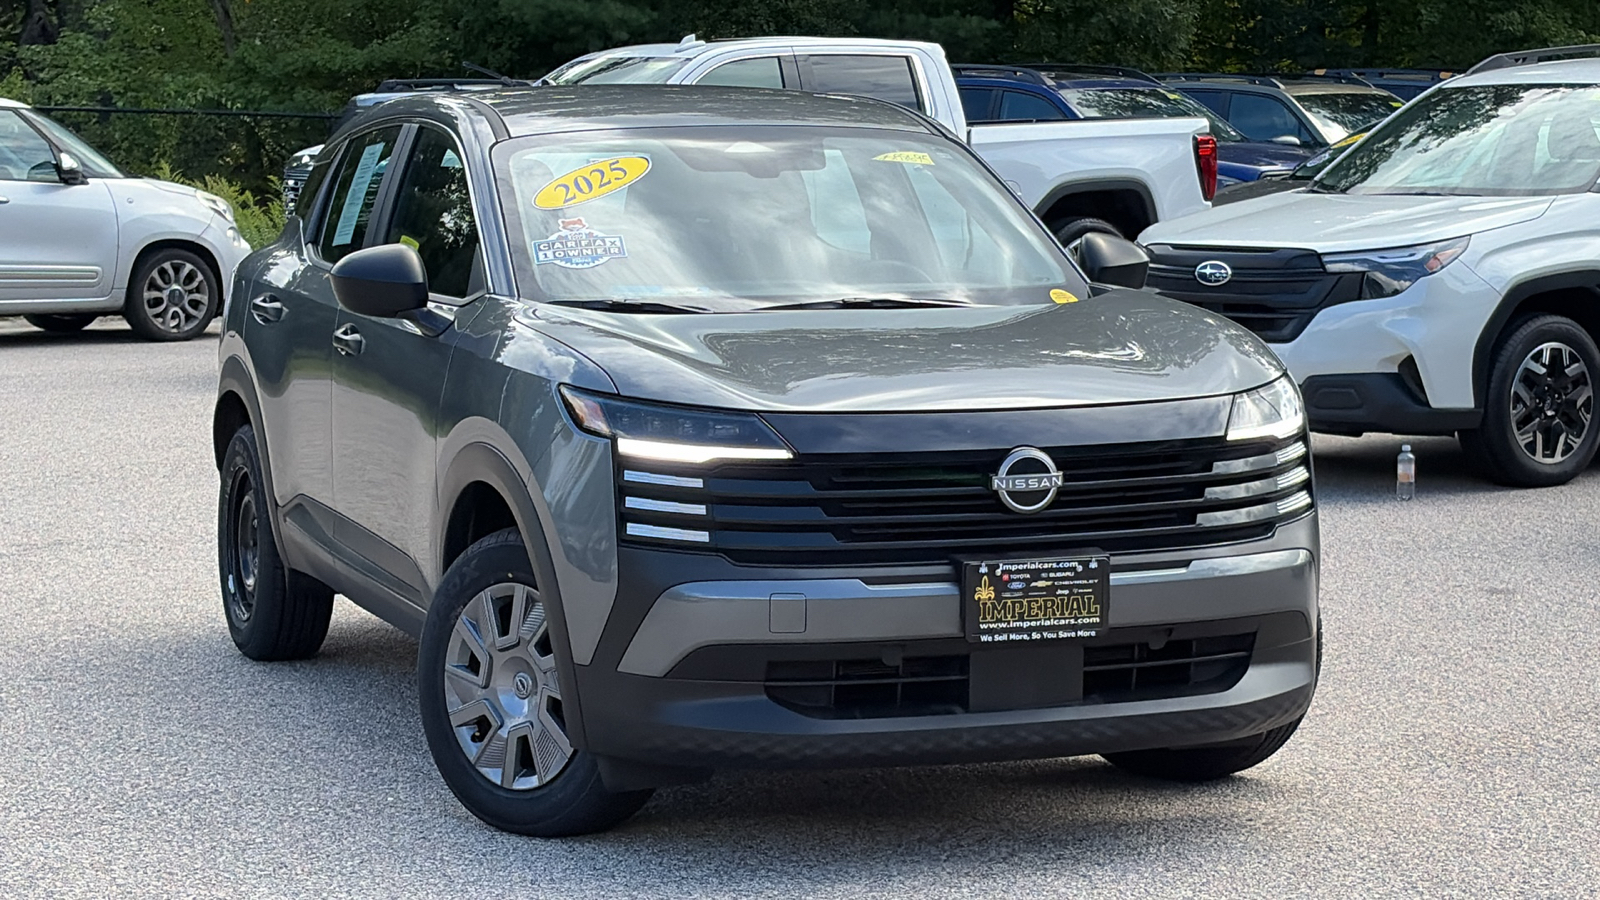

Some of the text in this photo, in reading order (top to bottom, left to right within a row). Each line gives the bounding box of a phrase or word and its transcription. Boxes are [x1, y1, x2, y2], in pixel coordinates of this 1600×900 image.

[554, 160, 628, 204] 2025
[538, 239, 618, 251] CARFAX
[554, 247, 619, 257] OWNER
[994, 476, 1062, 489] NISSAN
[999, 561, 1078, 571] Imperialcars.com
[979, 595, 1100, 622] IMPERIAL
[979, 616, 1100, 629] www.imperialcars.com
[980, 629, 1096, 642] We Sell More, So You Save More
